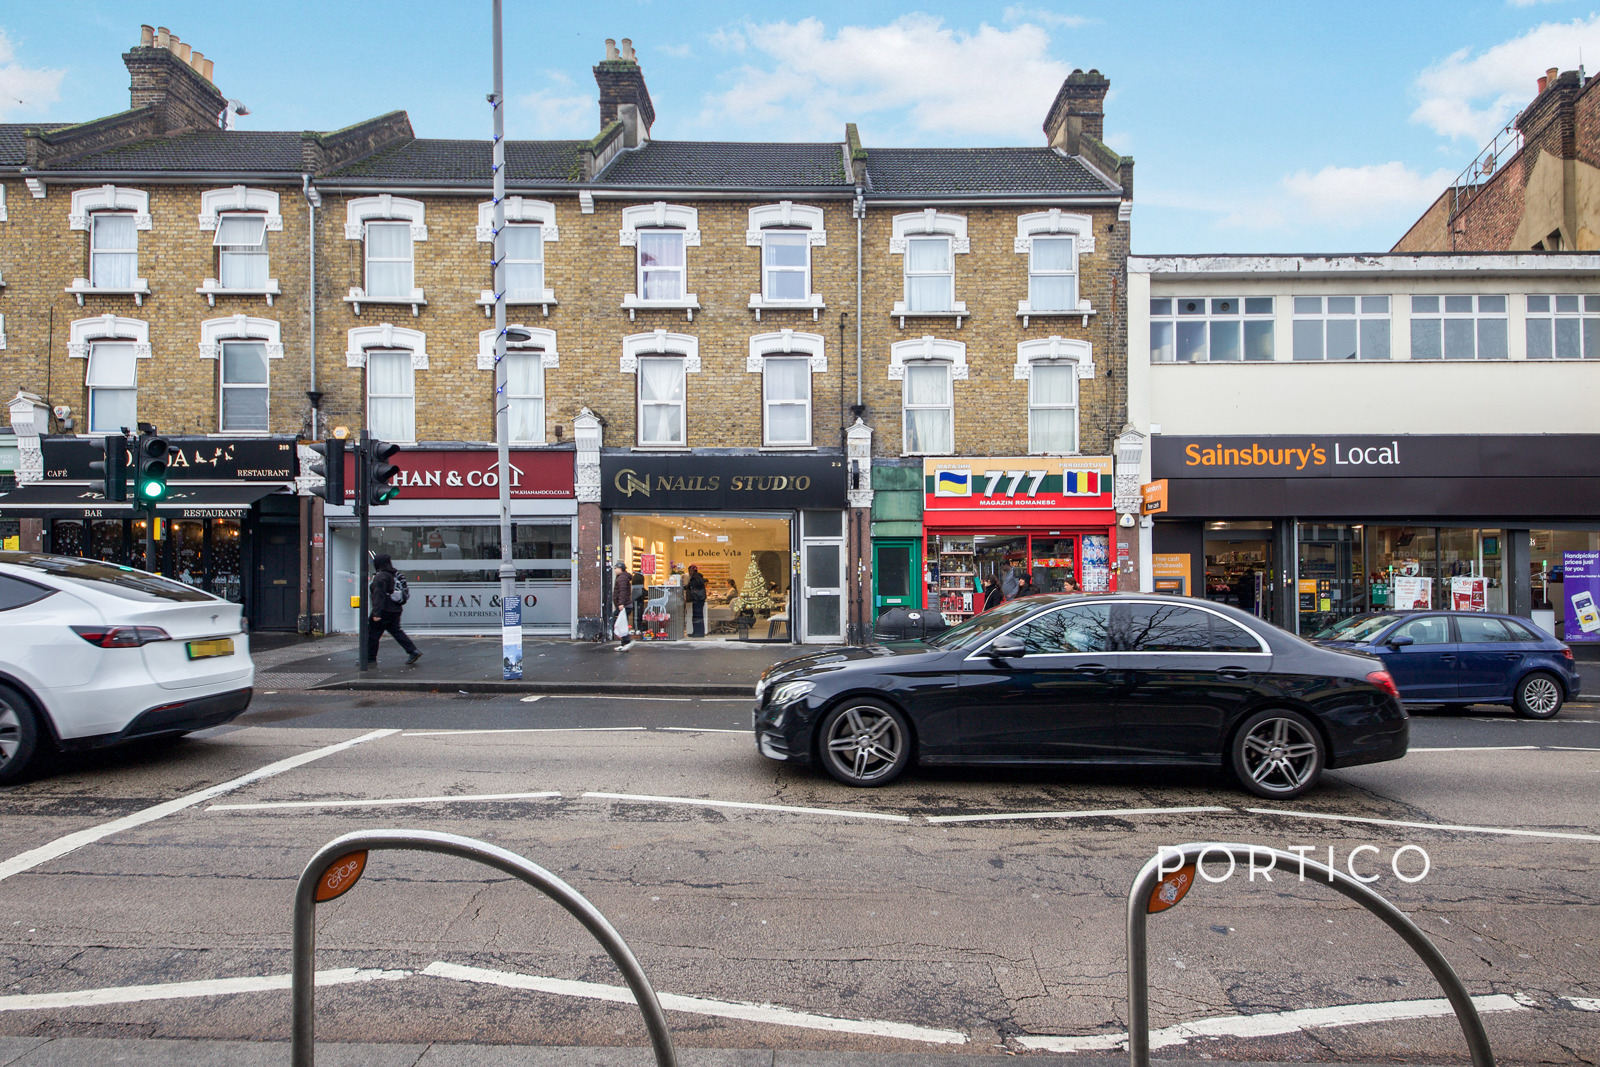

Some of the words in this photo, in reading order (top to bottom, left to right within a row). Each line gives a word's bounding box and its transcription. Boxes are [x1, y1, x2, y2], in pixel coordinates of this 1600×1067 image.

[1185, 443, 1327, 470] Sainsbury's
[1334, 441, 1400, 465] Local
[47, 469, 68, 477] CAFÉ
[388, 470, 442, 487] HAN
[446, 470, 464, 487] &
[656, 475, 720, 491] NAILS
[730, 475, 811, 491] STUDIO
[983, 469, 1049, 498] 777
[84, 509, 103, 517] BAR
[183, 509, 243, 517] RESTAURANT
[685, 549, 695, 557] La
[697, 549, 720, 557] Dolce
[722, 549, 742, 557] Vita
[1564, 552, 1599, 560] Handpicked
[424, 594, 482, 607] KHAN
[489, 594, 502, 607] &
